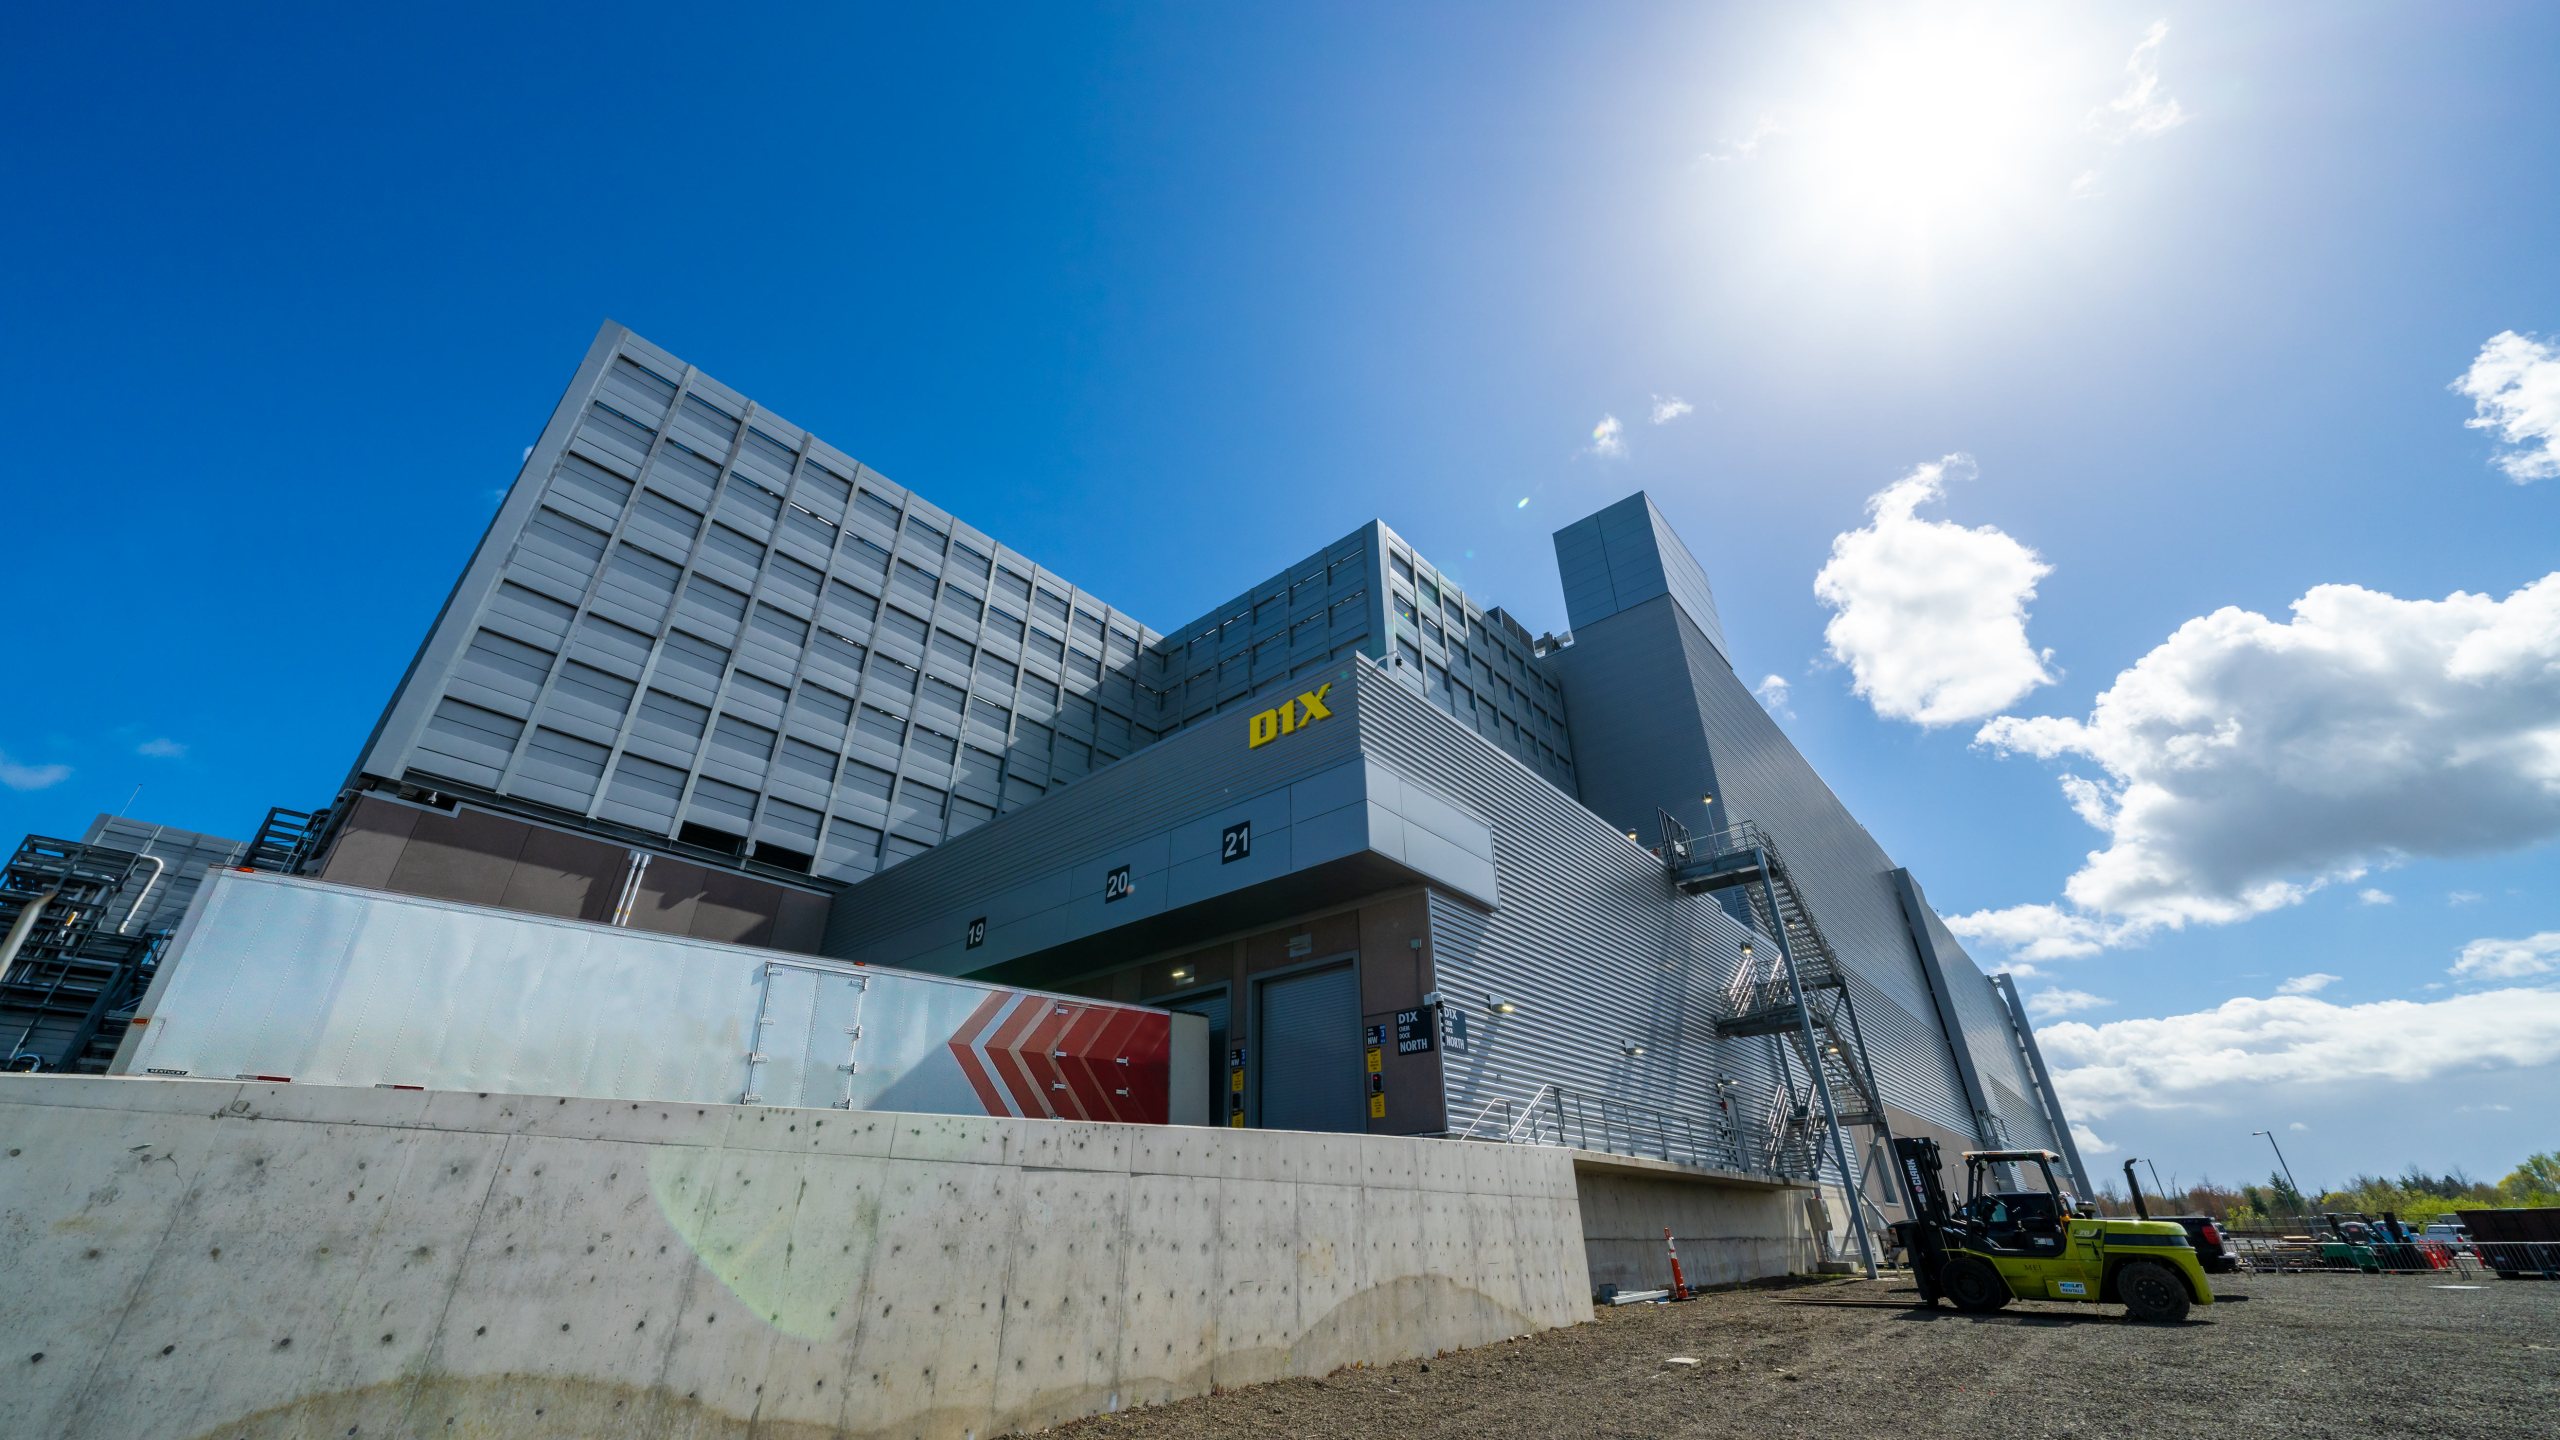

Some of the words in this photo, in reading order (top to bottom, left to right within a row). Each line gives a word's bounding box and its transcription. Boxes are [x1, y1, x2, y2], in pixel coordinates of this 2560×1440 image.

[1249, 682, 1333, 749] D1X
[1224, 827, 1249, 858] 21
[1106, 871, 1128, 898] 20
[968, 922, 984, 945] 19
[1398, 1011, 1418, 1024] D1X
[1400, 1038, 1428, 1053] NORTH
[1446, 1035, 1465, 1050] NORTH
[1905, 1158, 1922, 1186] CLARK
